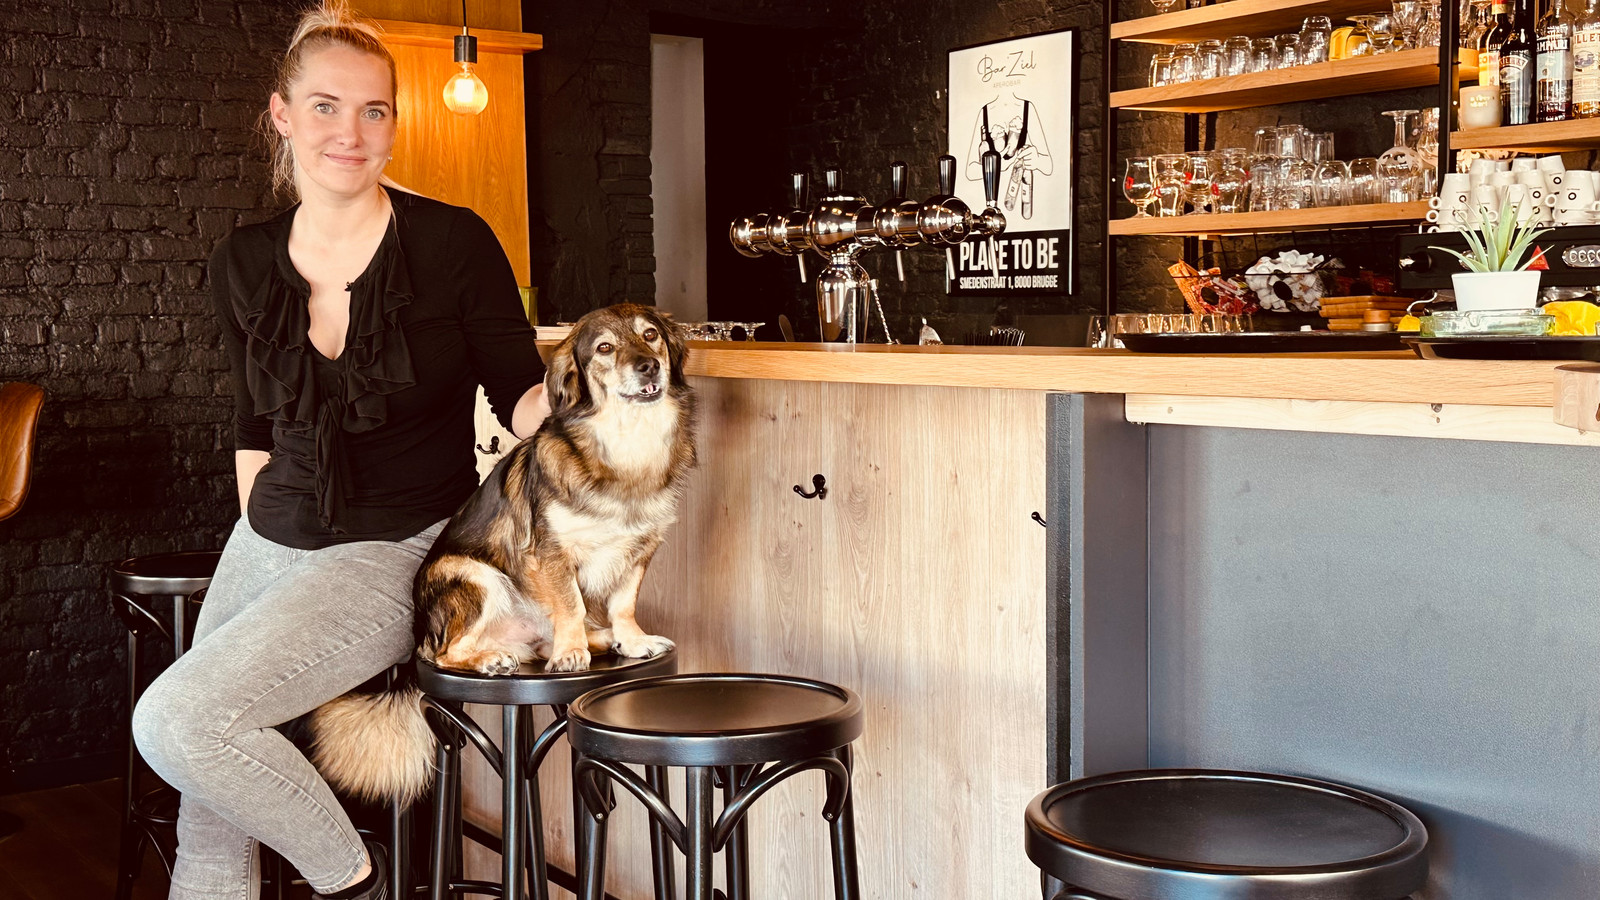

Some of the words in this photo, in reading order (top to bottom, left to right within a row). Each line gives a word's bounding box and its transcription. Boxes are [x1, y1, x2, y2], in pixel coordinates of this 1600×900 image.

[977, 54, 1006, 82] Bar
[1006, 51, 1036, 77] Ziel
[960, 240, 1008, 271] PLACE
[1012, 238, 1032, 270] TO
[1036, 237, 1059, 269] BE
[960, 276, 1006, 289] SMEDENSTRAAT
[1008, 276, 1013, 290] 1,
[1015, 275, 1031, 288] 8000
[1032, 275, 1058, 288] BRUGGE
